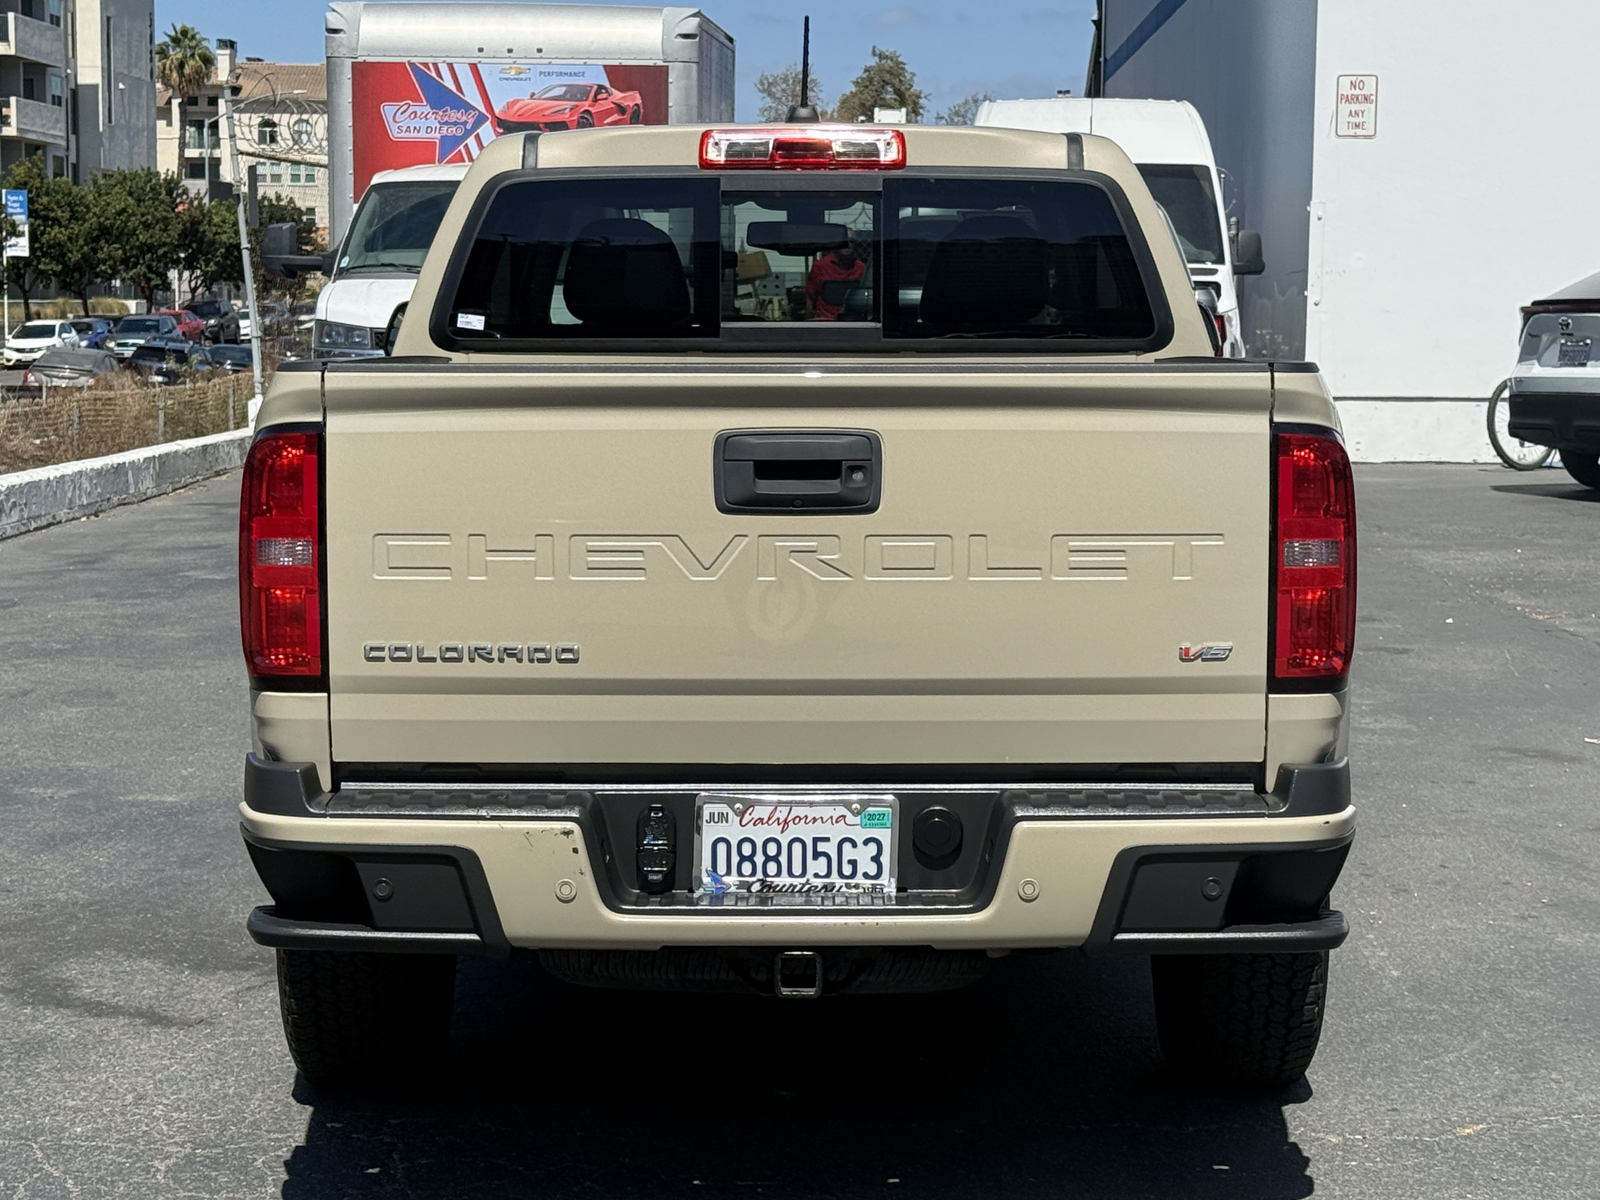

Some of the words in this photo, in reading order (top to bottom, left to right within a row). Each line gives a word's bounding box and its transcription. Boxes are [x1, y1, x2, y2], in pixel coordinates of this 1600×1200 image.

[1350, 79, 1365, 91] NO
[1340, 93, 1375, 105] PARKING
[392, 101, 478, 129] Courtesy
[1348, 109, 1366, 119] ANY
[396, 125, 421, 135] SAN
[425, 125, 464, 136] DIEGO
[1347, 121, 1367, 131] TIME
[372, 532, 1225, 583] CHEVROLET
[363, 642, 581, 664] COLORADO
[705, 811, 730, 824] JUN
[738, 805, 860, 834] California
[866, 812, 886, 822] 2027
[711, 836, 884, 880] 08805G3
